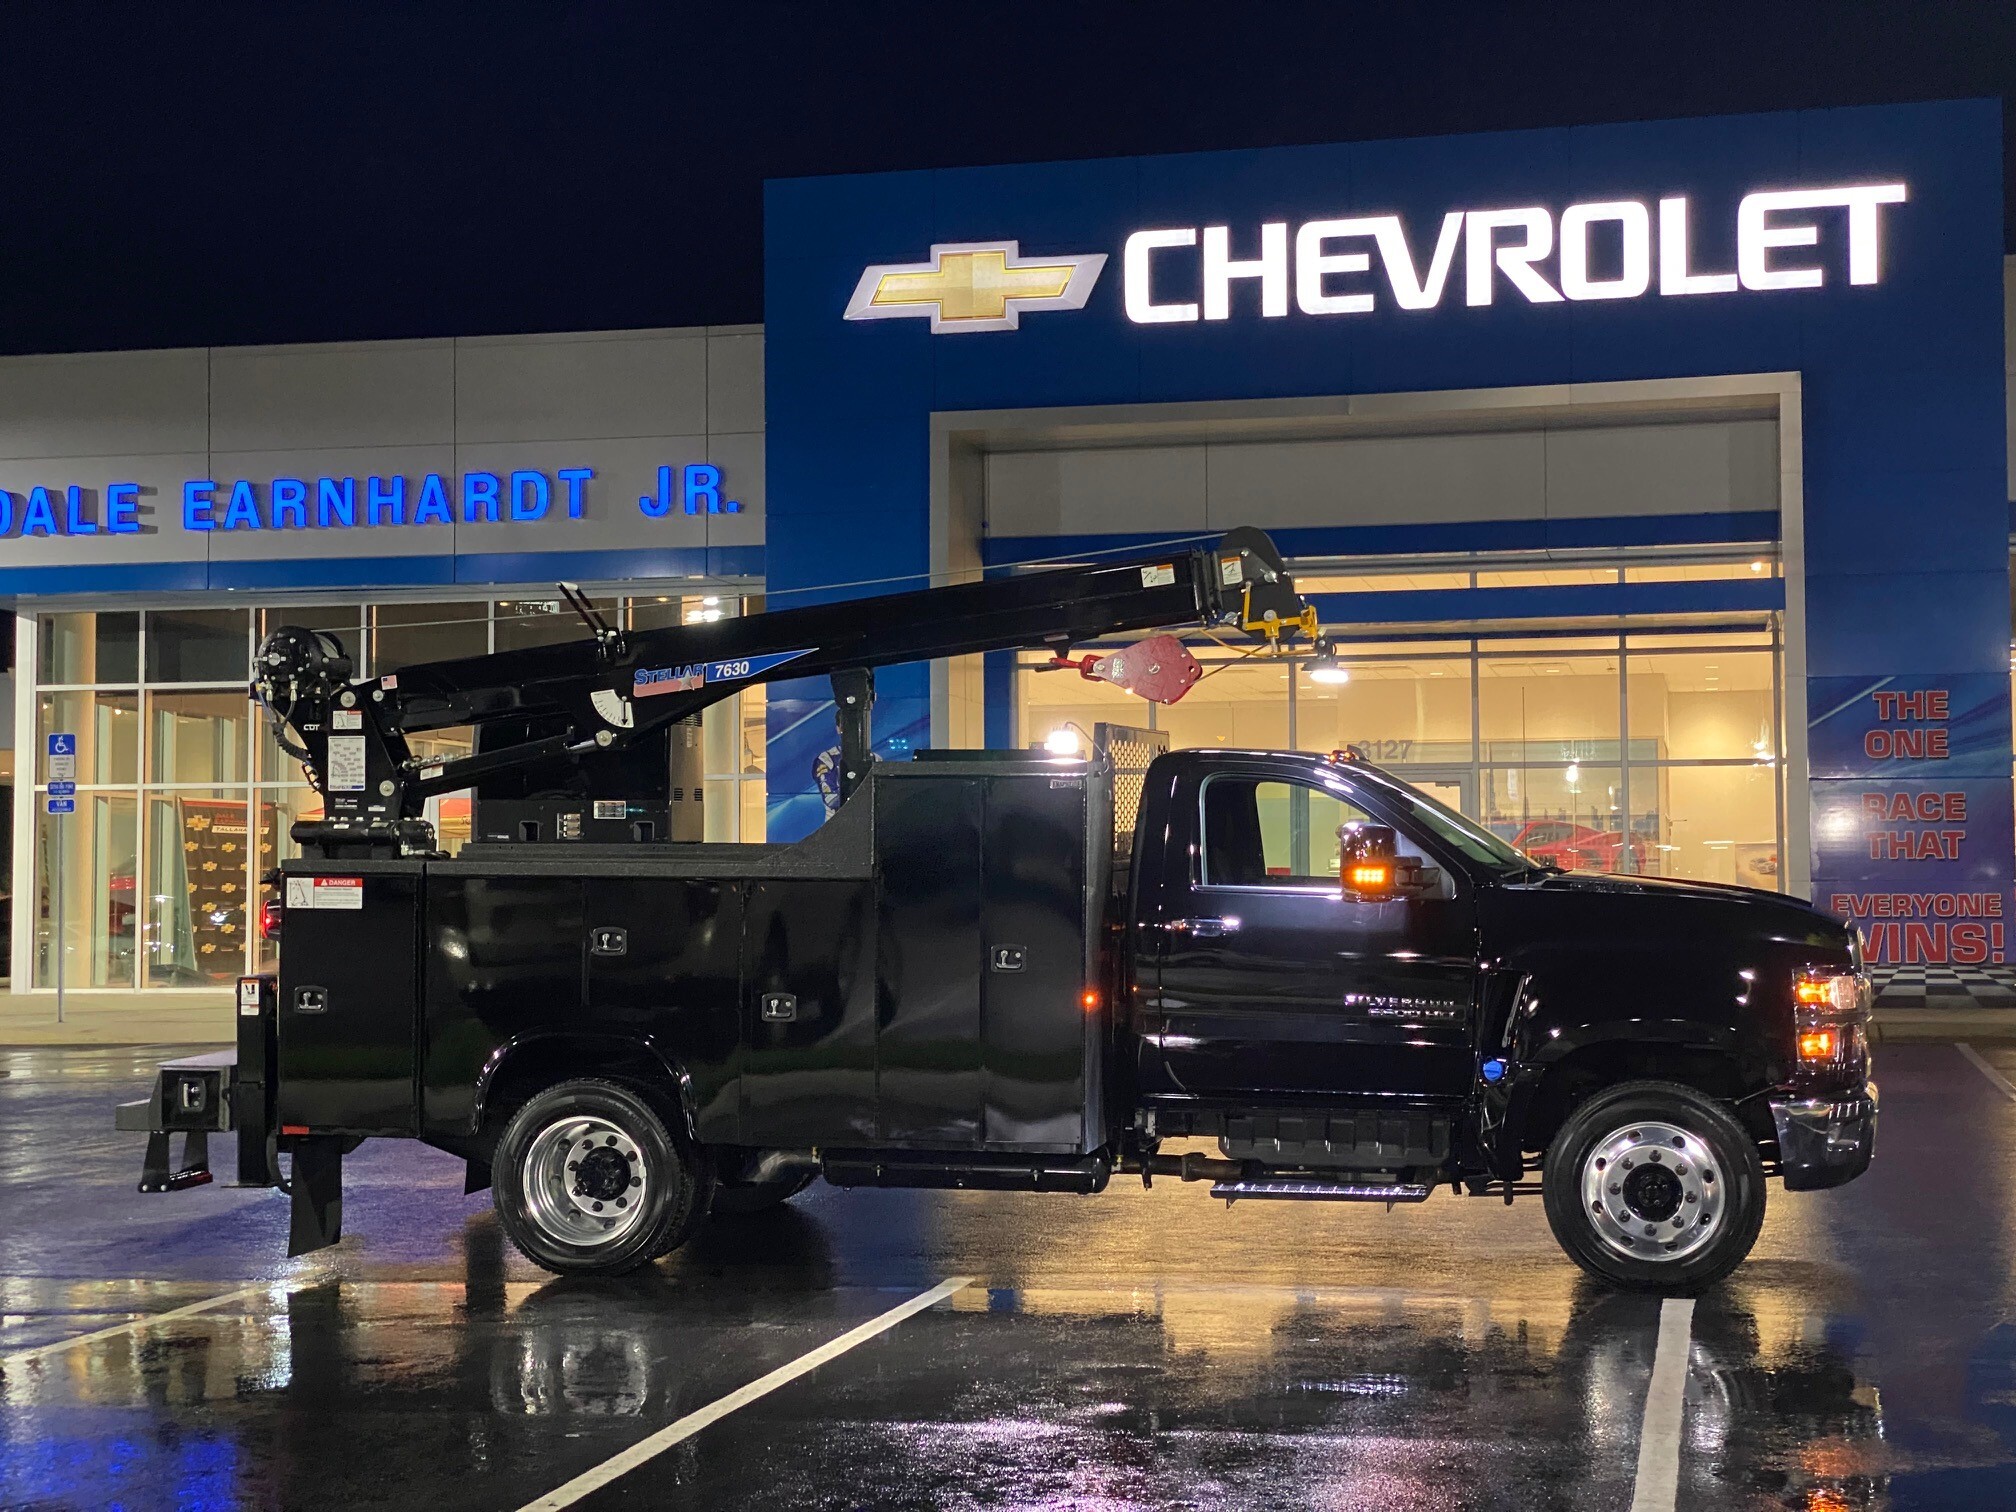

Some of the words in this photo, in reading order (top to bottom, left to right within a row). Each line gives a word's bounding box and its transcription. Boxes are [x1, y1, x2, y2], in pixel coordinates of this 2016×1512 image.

[1124, 185, 1906, 324] CHEVROLET
[184, 469, 593, 530] EARNHARDT
[639, 464, 739, 518] JR.
[634, 663, 704, 685] STELLAR
[715, 661, 749, 678] 7630
[1873, 690, 1949, 721] THE
[1358, 739, 1413, 760] 3127
[1865, 729, 1949, 759] ONE
[1862, 792, 1967, 822] RACE
[1865, 831, 1966, 860] THAT
[1831, 893, 2003, 919] EVERYONE
